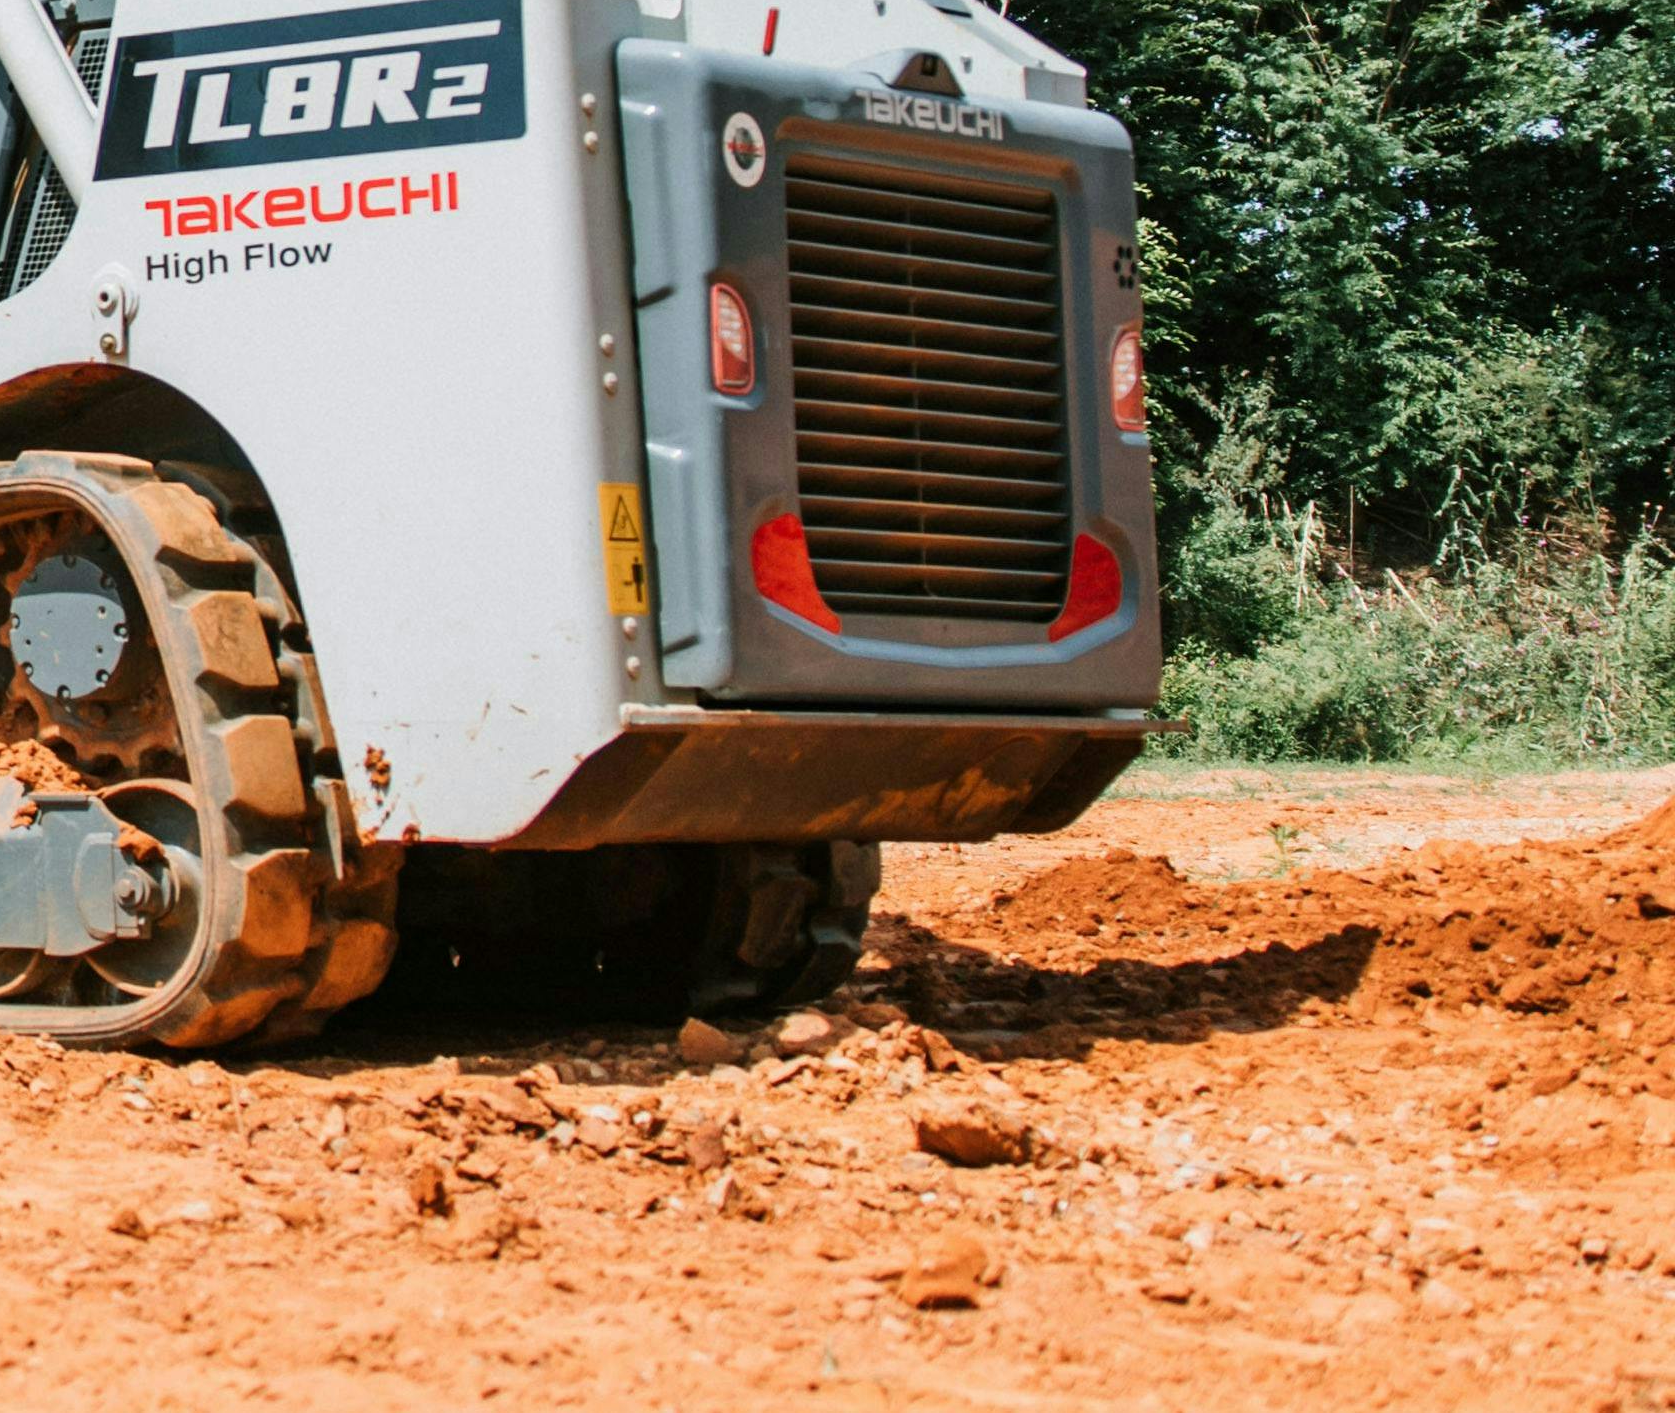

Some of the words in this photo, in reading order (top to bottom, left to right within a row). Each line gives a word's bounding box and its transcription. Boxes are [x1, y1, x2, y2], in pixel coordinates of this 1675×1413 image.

[855, 89, 1003, 141] TAKEUCHI
[145, 172, 459, 237] TAKEUCHI
[146, 249, 229, 284] High
[244, 243, 332, 272] Flow
